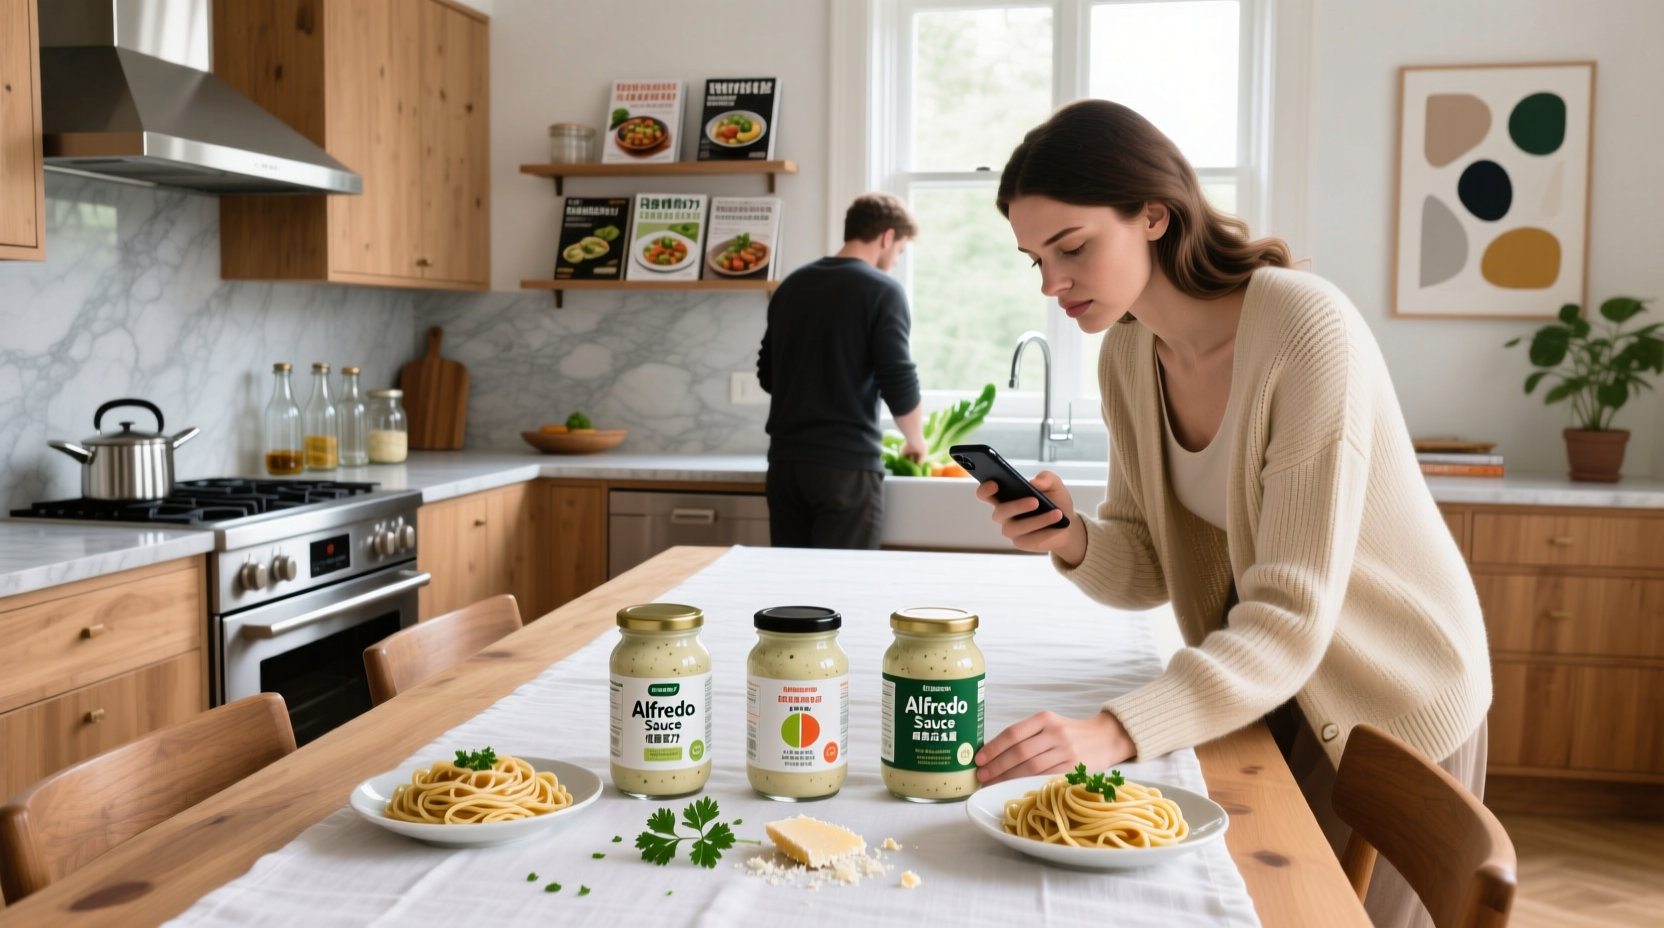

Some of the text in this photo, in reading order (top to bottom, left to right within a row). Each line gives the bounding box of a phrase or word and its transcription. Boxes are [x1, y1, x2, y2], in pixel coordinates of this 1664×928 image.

[632, 700, 695, 718] Alfredo
[905, 696, 968, 715] Alfredo
[644, 720, 682, 731] Sauce
[914, 715, 956, 729] Sauce
